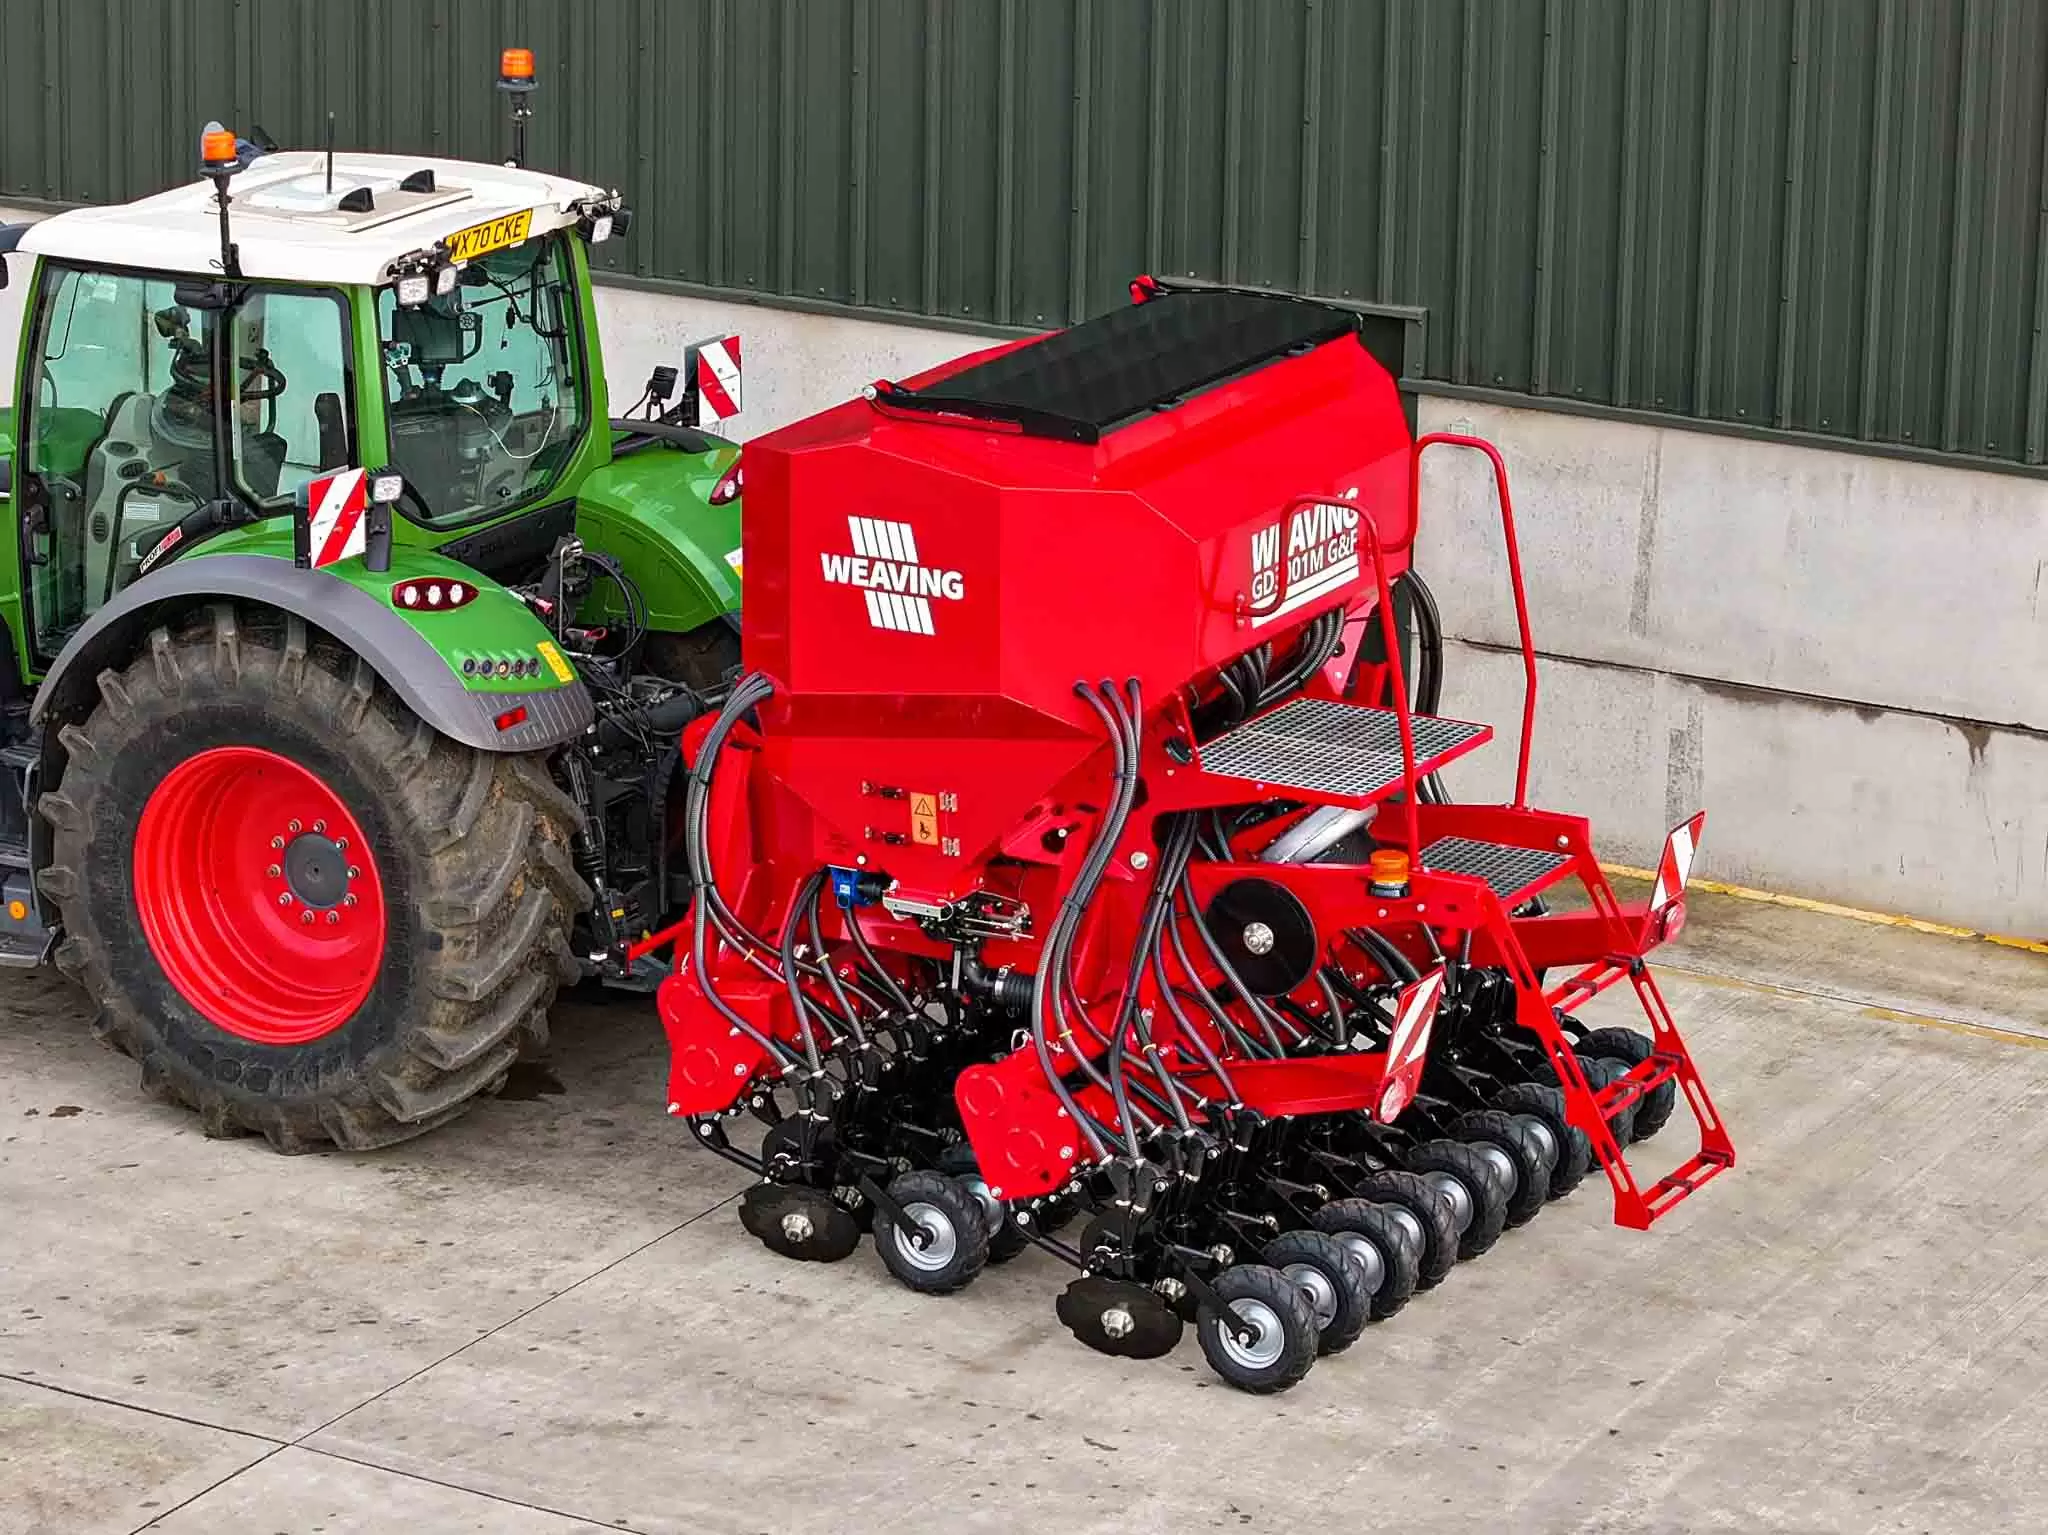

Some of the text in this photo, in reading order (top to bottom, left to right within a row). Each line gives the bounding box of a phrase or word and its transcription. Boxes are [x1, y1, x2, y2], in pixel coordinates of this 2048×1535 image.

[494, 215, 525, 244] CKE
[820, 552, 964, 600] WEAVING
[1251, 527, 1358, 601] GD01M G&F
